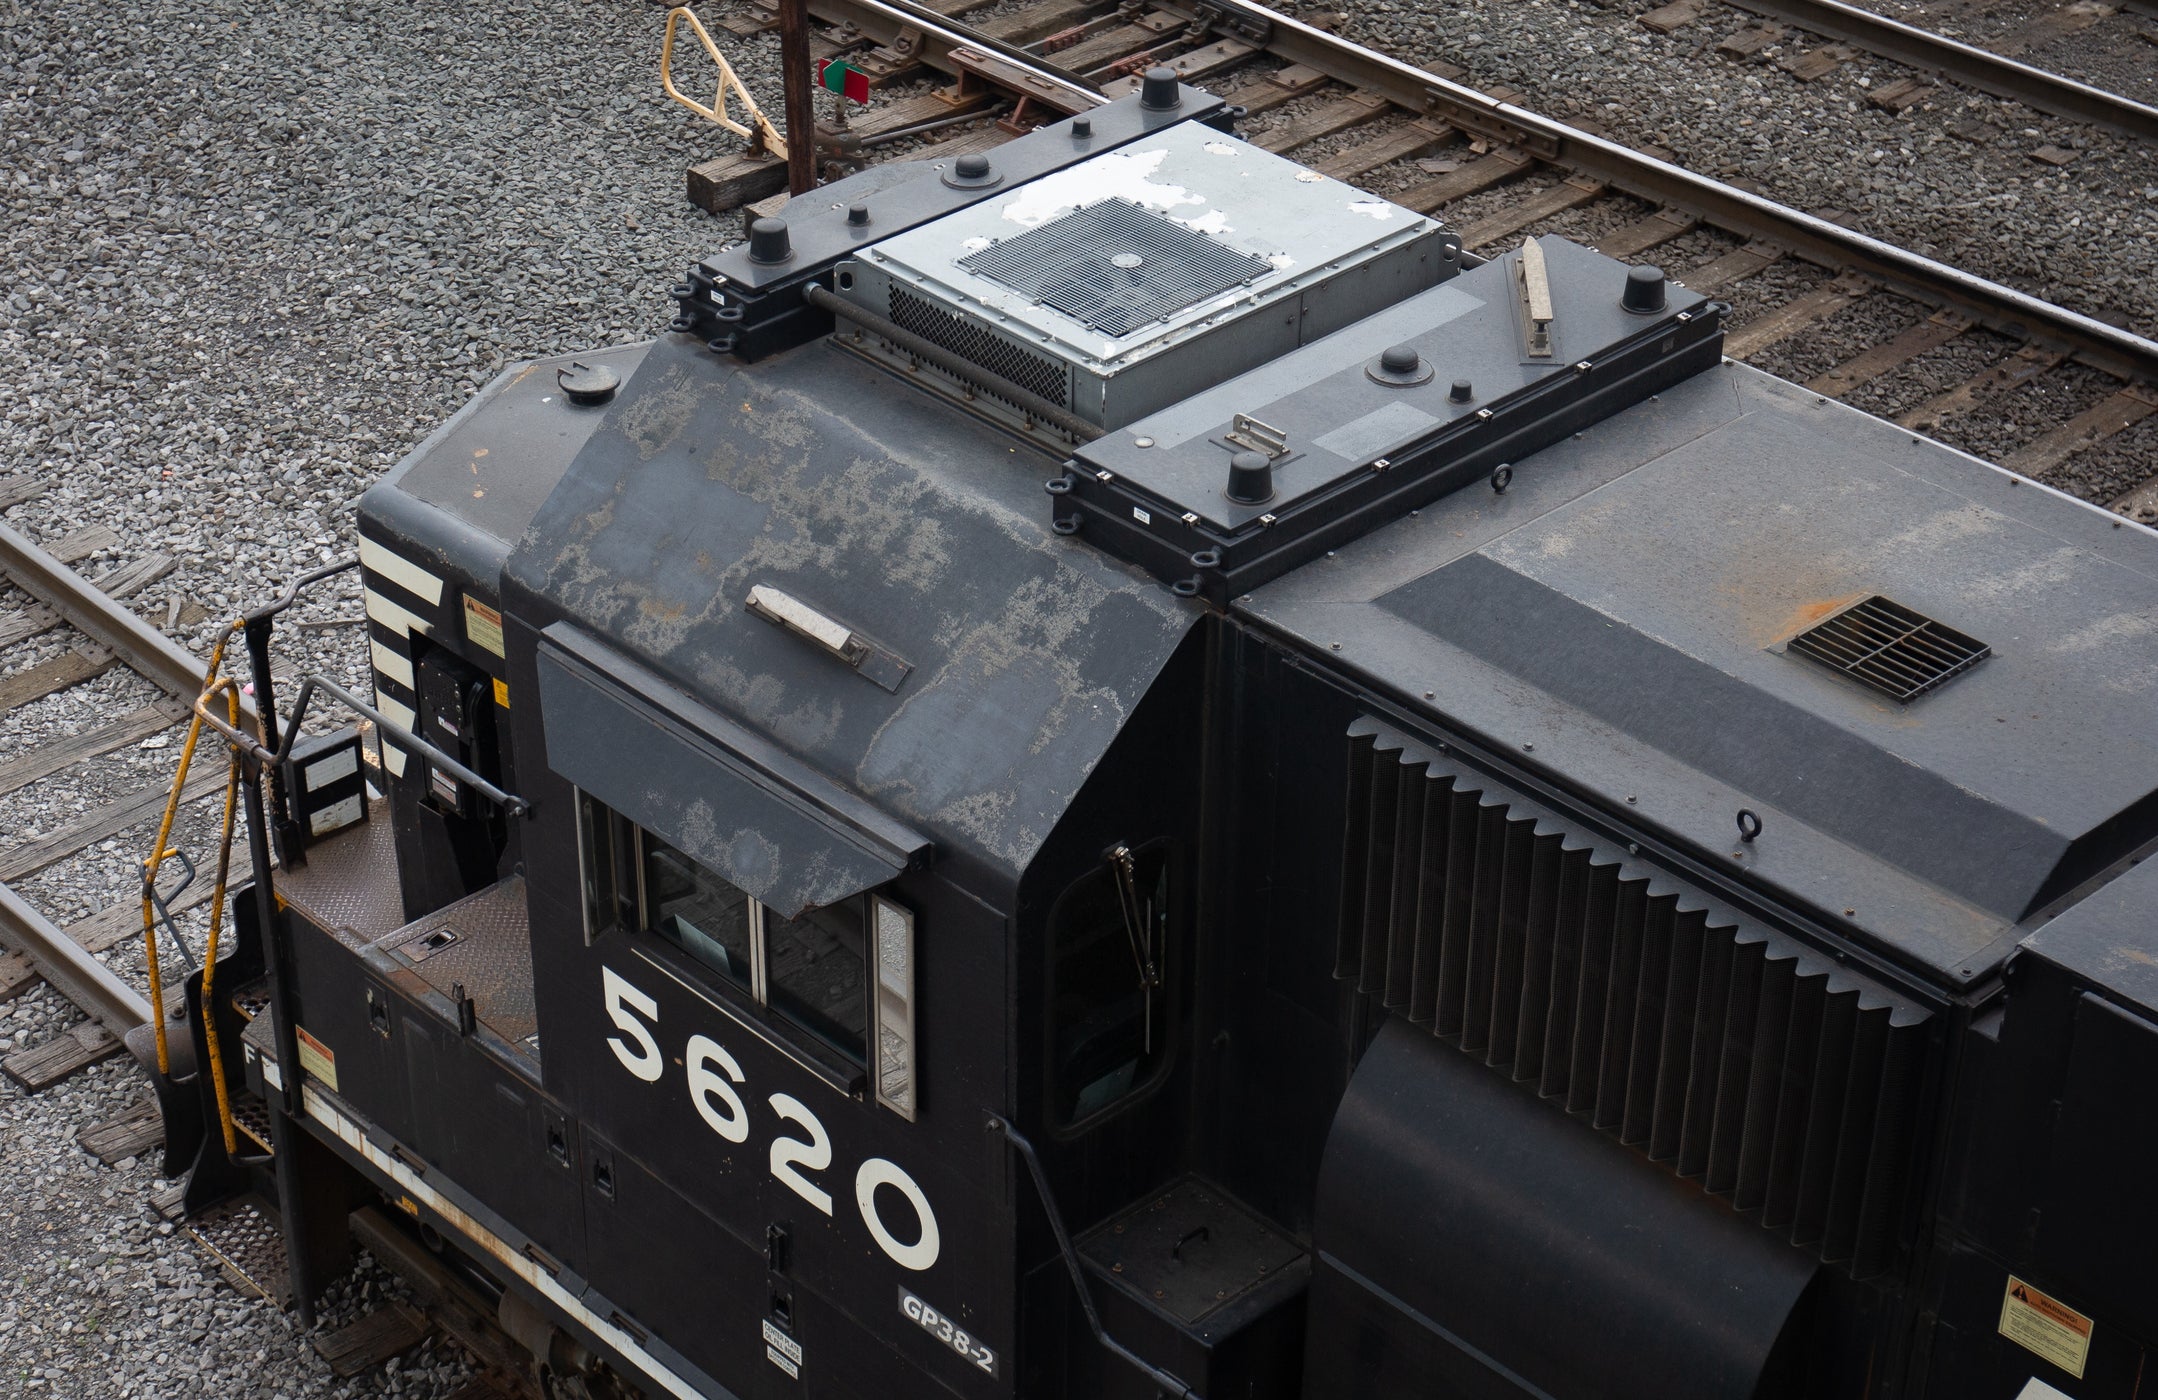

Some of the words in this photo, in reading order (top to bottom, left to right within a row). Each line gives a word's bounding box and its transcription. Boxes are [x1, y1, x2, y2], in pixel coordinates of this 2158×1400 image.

[243, 1043, 256, 1064] F
[602, 965, 940, 1270] 5620
[903, 1295, 994, 1373] GP38-2
[2040, 1299, 2078, 1323] WARNING!
